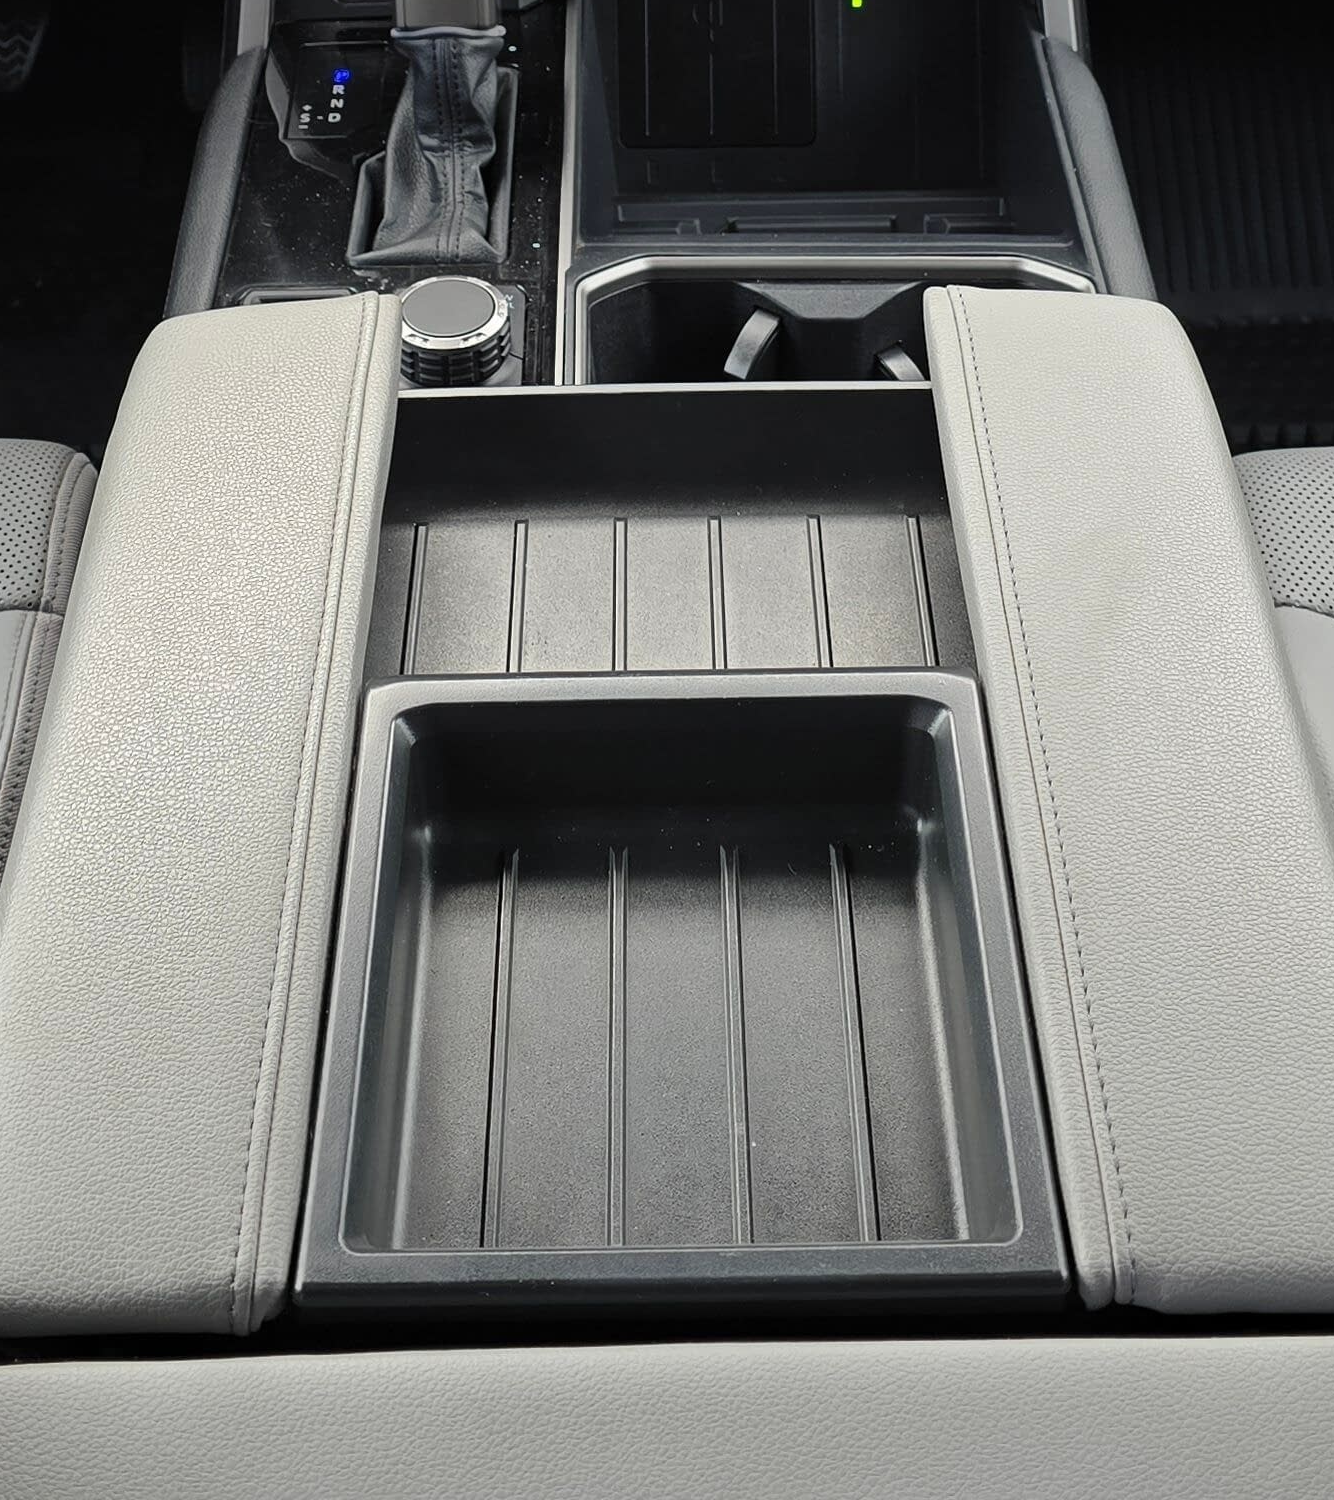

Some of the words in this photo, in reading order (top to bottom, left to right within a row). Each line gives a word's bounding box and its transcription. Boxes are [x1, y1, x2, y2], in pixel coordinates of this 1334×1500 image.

[332, 84, 345, 95] R
[330, 98, 344, 108] N
[300, 112, 311, 123] S
[327, 112, 342, 123] D
